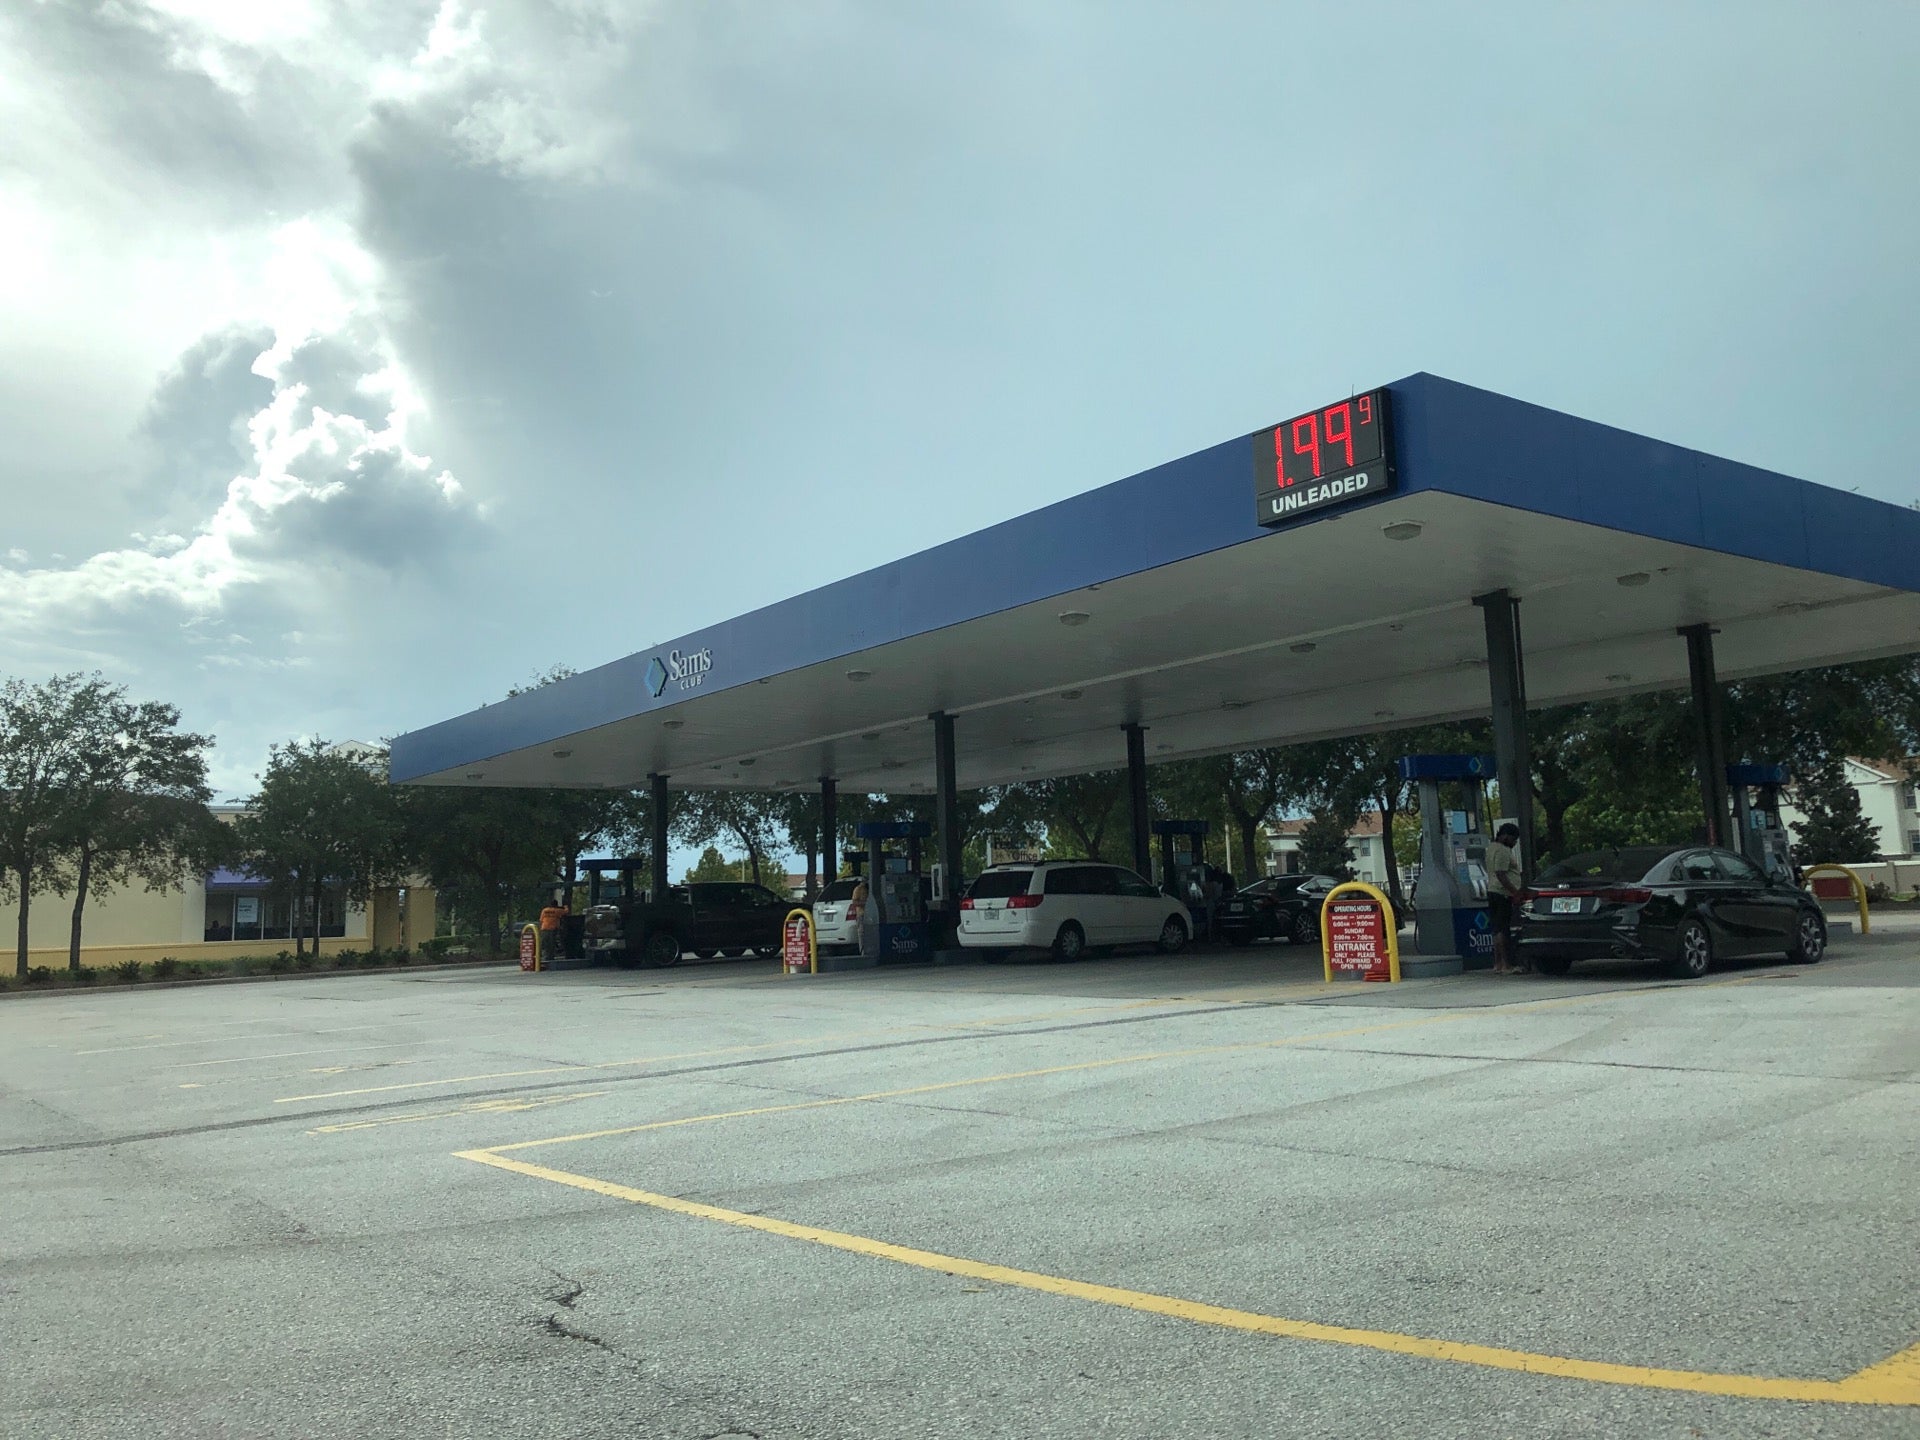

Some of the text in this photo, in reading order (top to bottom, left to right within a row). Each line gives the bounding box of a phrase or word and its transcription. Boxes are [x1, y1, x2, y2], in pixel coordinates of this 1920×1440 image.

[1274, 401, 1354, 489] 1.99
[1272, 473, 1369, 514] UNLEADED
[669, 647, 712, 681] Sam's
[680, 675, 702, 690] CLUB
[1333, 943, 1376, 951] ENTRANCE
[1469, 928, 1494, 948] Sam
